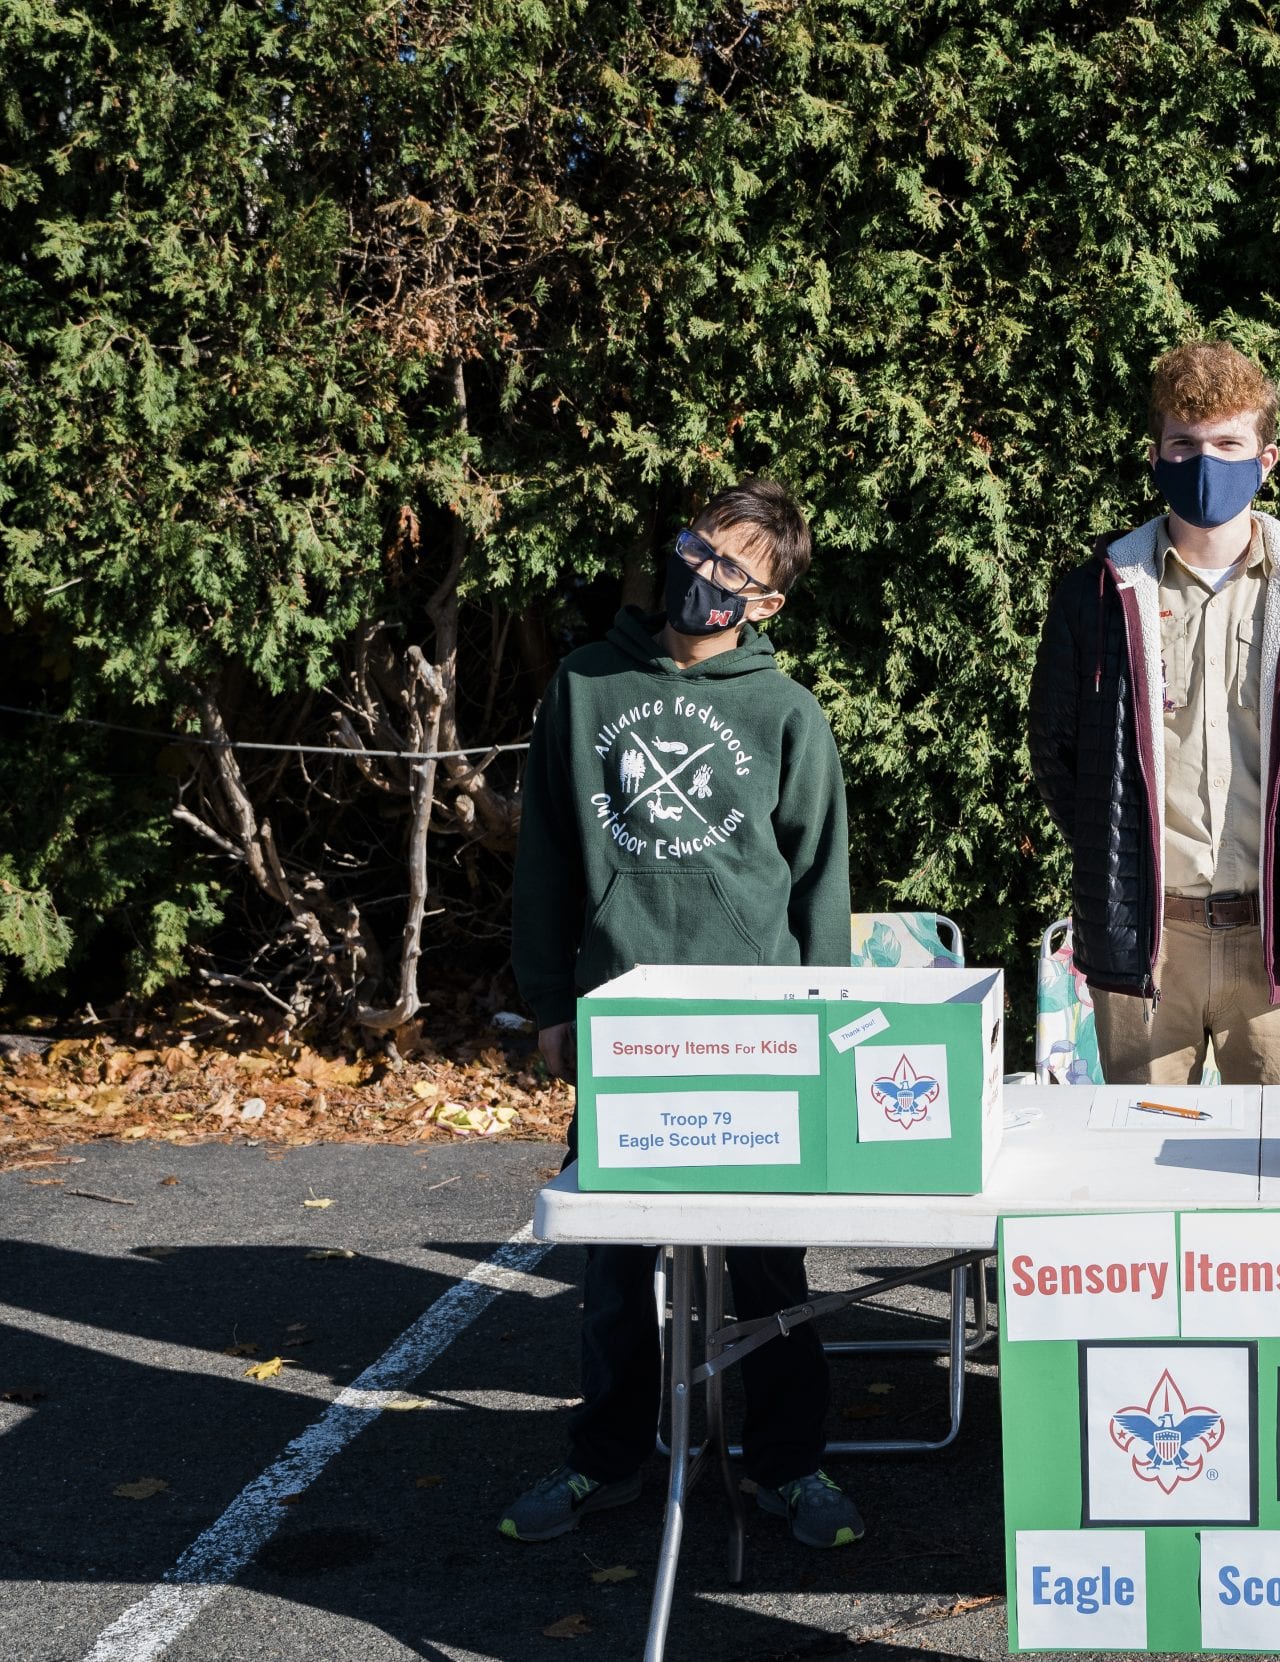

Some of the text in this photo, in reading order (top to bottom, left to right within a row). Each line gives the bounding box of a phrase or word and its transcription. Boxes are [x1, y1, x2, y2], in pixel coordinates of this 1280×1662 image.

[594, 696, 753, 777] Alliance Redwoods
[590, 792, 745, 860] Outdoor Education
[840, 1019, 876, 1041] Thank you!
[612, 1040, 798, 1058] Sensory Items For Kids
[660, 1112, 732, 1129] Troop 79
[618, 1131, 780, 1151] Eagle Scout Project
[1012, 1254, 1169, 1300] Sensory
[1031, 1564, 1136, 1616] Eagle
